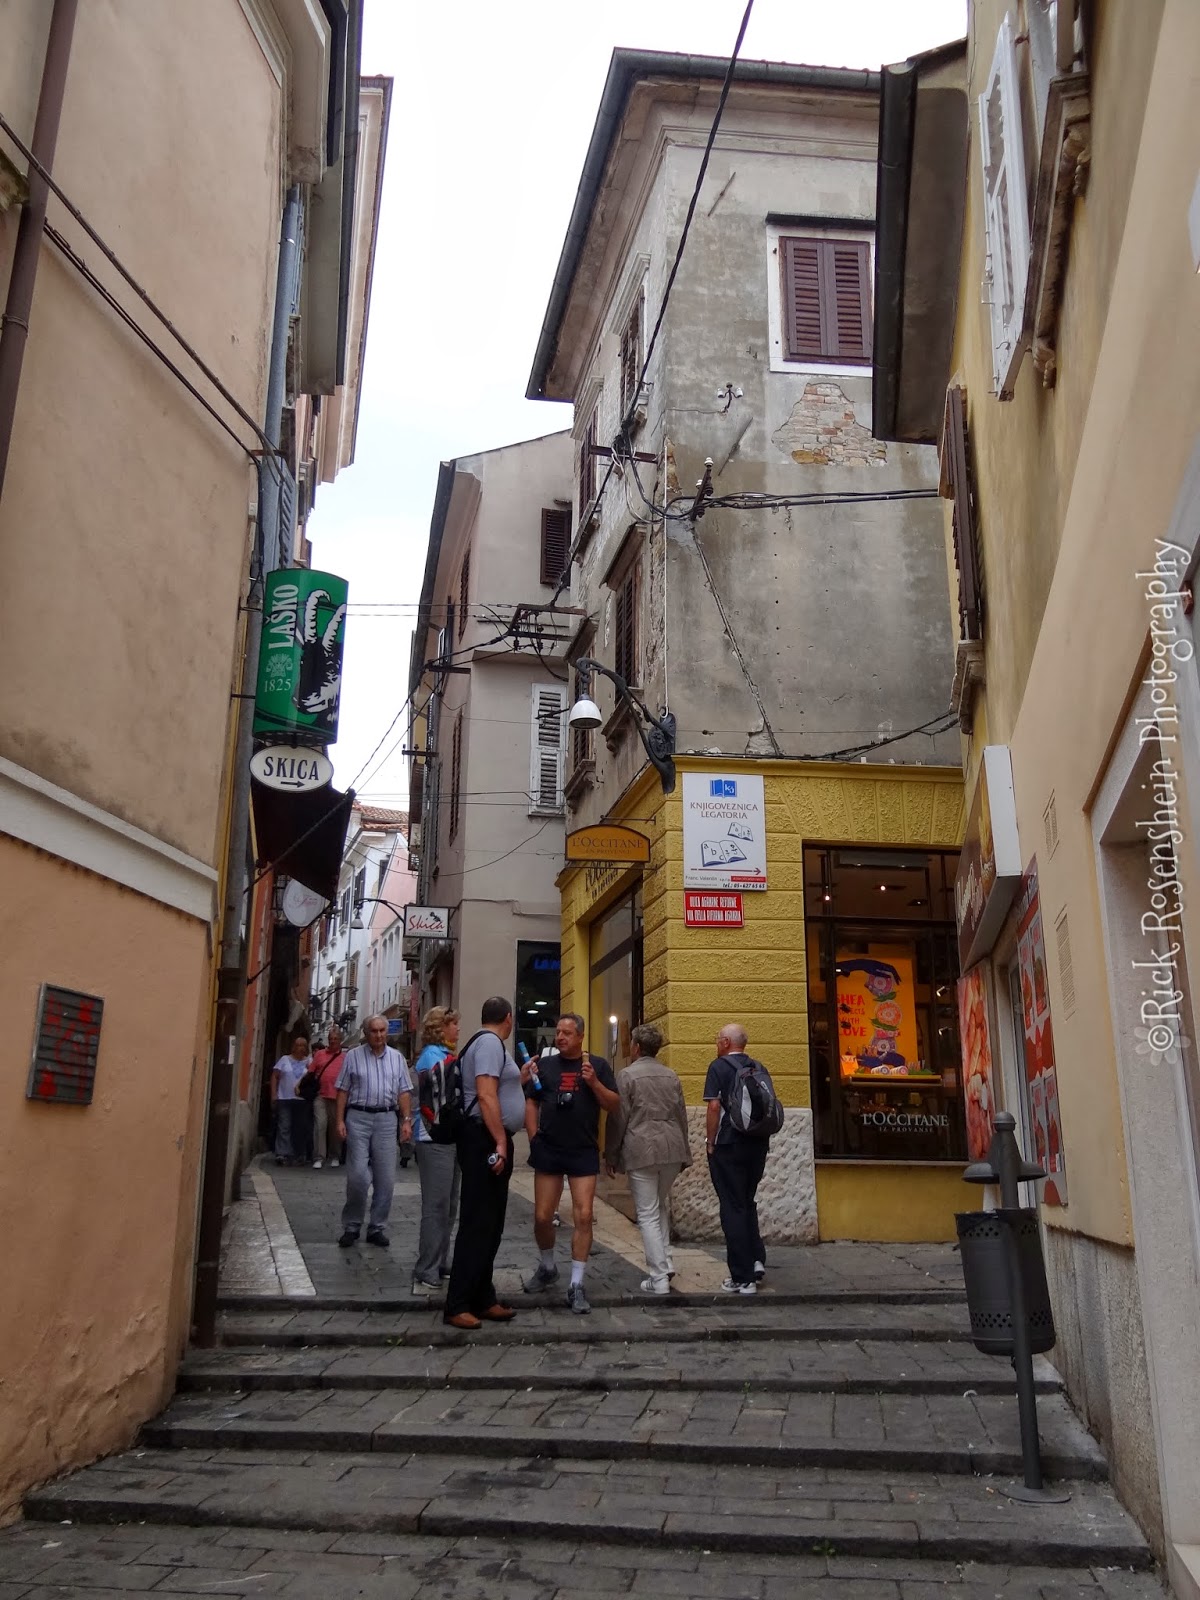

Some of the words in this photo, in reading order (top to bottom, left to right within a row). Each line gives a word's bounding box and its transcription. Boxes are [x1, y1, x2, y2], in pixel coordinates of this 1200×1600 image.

[264, 584, 299, 650] LAŠKO
[264, 679, 292, 693] 1825
[263, 756, 320, 781] SKICA
[690, 802, 759, 812] KNJIGOVEZNICA
[701, 811, 748, 820] LEGATORIA
[572, 836, 644, 849] L'OCCITANE
[861, 1111, 949, 1127] L'OCCITANE
